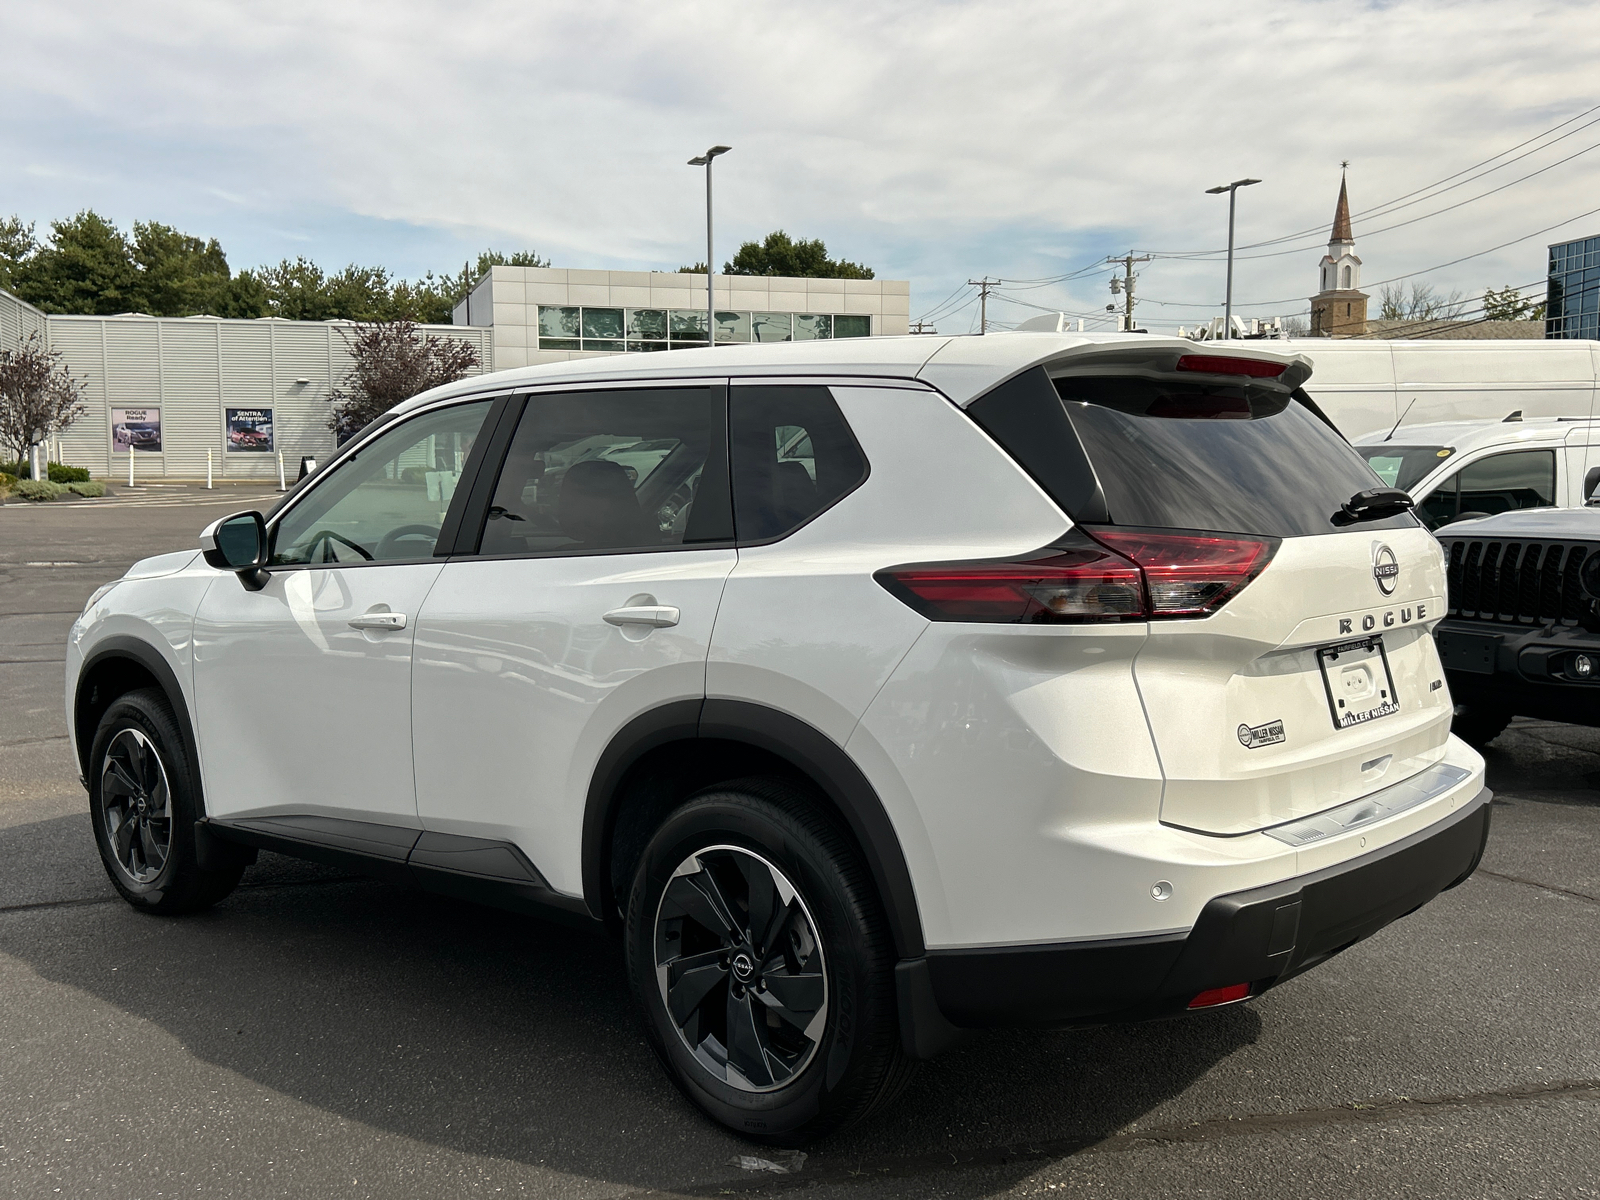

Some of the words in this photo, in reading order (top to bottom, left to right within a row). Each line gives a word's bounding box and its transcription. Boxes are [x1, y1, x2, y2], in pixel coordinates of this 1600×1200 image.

[1339, 604, 1427, 635] ROGUE
[1340, 711, 1370, 727] MILLER
[1371, 703, 1400, 718] NISSAN
[1252, 729, 1268, 739] MILLER
[1268, 725, 1284, 736] NISSAN
